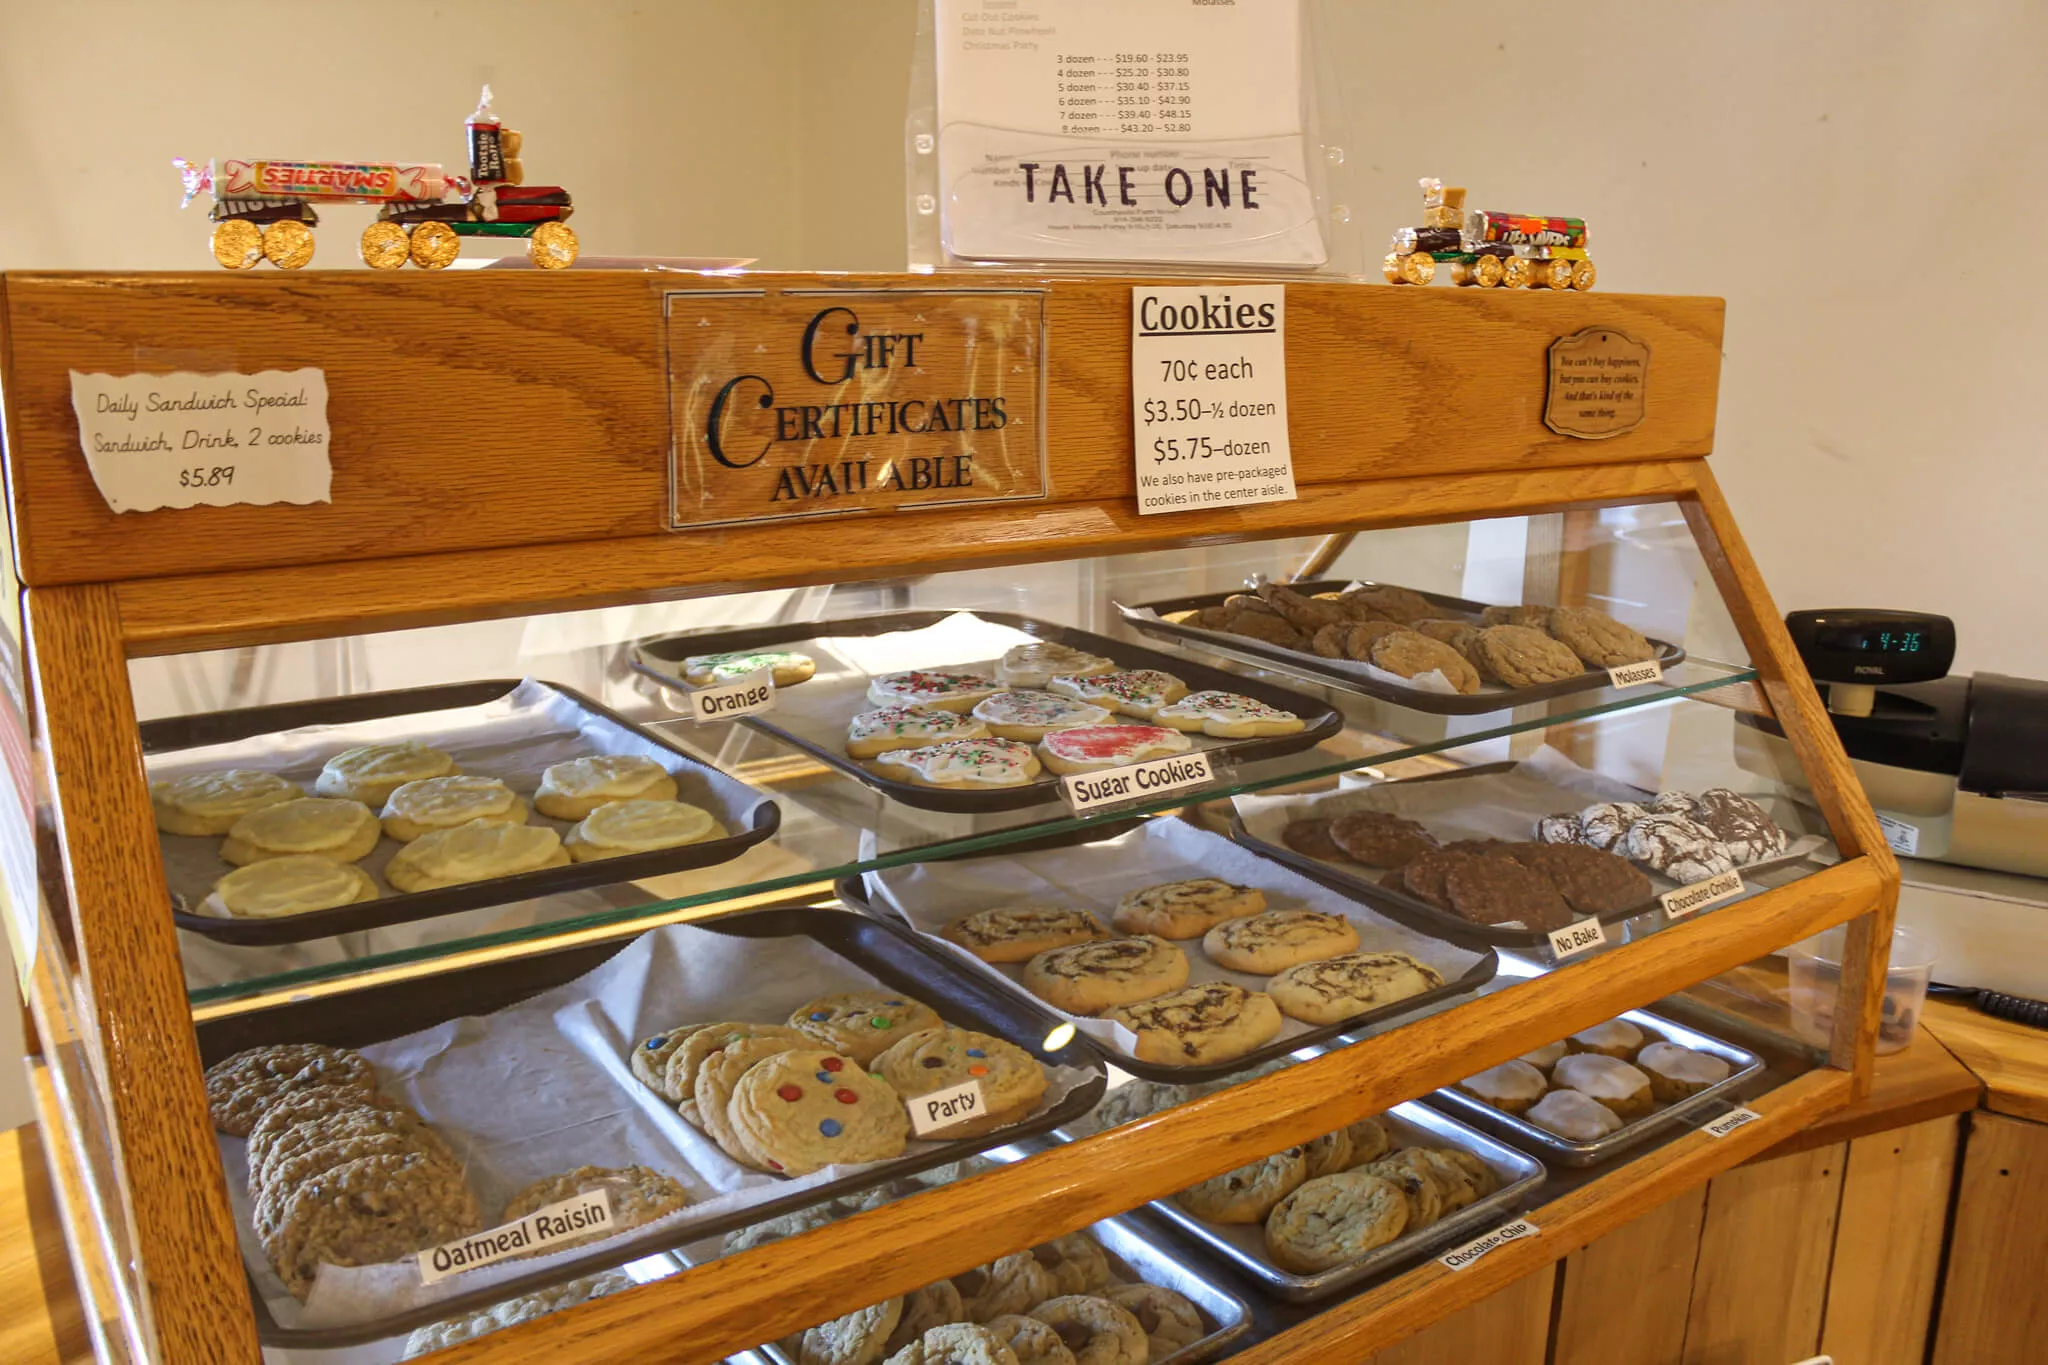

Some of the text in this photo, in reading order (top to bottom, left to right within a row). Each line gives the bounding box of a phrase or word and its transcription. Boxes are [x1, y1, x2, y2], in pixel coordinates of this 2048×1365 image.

[1065, 54, 1095, 64] dozen
[1115, 53, 1149, 63] $19.60
[1156, 53, 1189, 63] $23.95
[1065, 69, 1096, 78] dozen
[1115, 67, 1149, 78] $25.20
[1156, 67, 1190, 77] $30.80
[1066, 83, 1096, 92] dozen
[1116, 81, 1150, 92] $30.40
[1157, 81, 1191, 91] $37.15
[1067, 97, 1097, 106] dozen
[1117, 96, 1150, 106] $35.10
[1158, 95, 1191, 105] $42.90
[1068, 110, 1097, 120] dozen
[1118, 110, 1151, 120] $39.40
[1159, 109, 1192, 119] $48.15
[1071, 124, 1101, 134] dozen
[1120, 123, 1154, 133] $43.20
[477, 133, 489, 178] Tootsie
[488, 143, 500, 171] Roll
[263, 167, 391, 188] SMARTIES
[1019, 163, 1260, 209] TAKE ONE
[1141, 295, 1276, 331] Cookies
[802, 306, 924, 385] GIFT
[1161, 356, 1253, 383] 70¢ each
[96, 393, 139, 420] Daily
[145, 391, 238, 414] Sandwich
[1229, 400, 1276, 418] dozen
[706, 375, 1008, 469] CERTIFICATES
[94, 426, 324, 453] Sandwich, Drink, 2 cookies
[178, 465, 236, 488] $5.89
[770, 455, 974, 502] AVAILABLE
[1140, 464, 1288, 488] We also have pre-packaged
[1144, 484, 1289, 508] cookies in the center aisle.
[1615, 667, 1657, 685] Molasses
[1854, 665, 1885, 675] ROYAL
[702, 686, 770, 714] Orange
[1074, 760, 1207, 802] Sugar Cookies
[1667, 875, 1740, 913] Chocolate Crinkle
[1555, 927, 1600, 953] No Bake
[927, 1092, 976, 1122] Party
[432, 1202, 607, 1272] Oatmeal Raisin
[1445, 1223, 1528, 1267] Chocolate Chip
